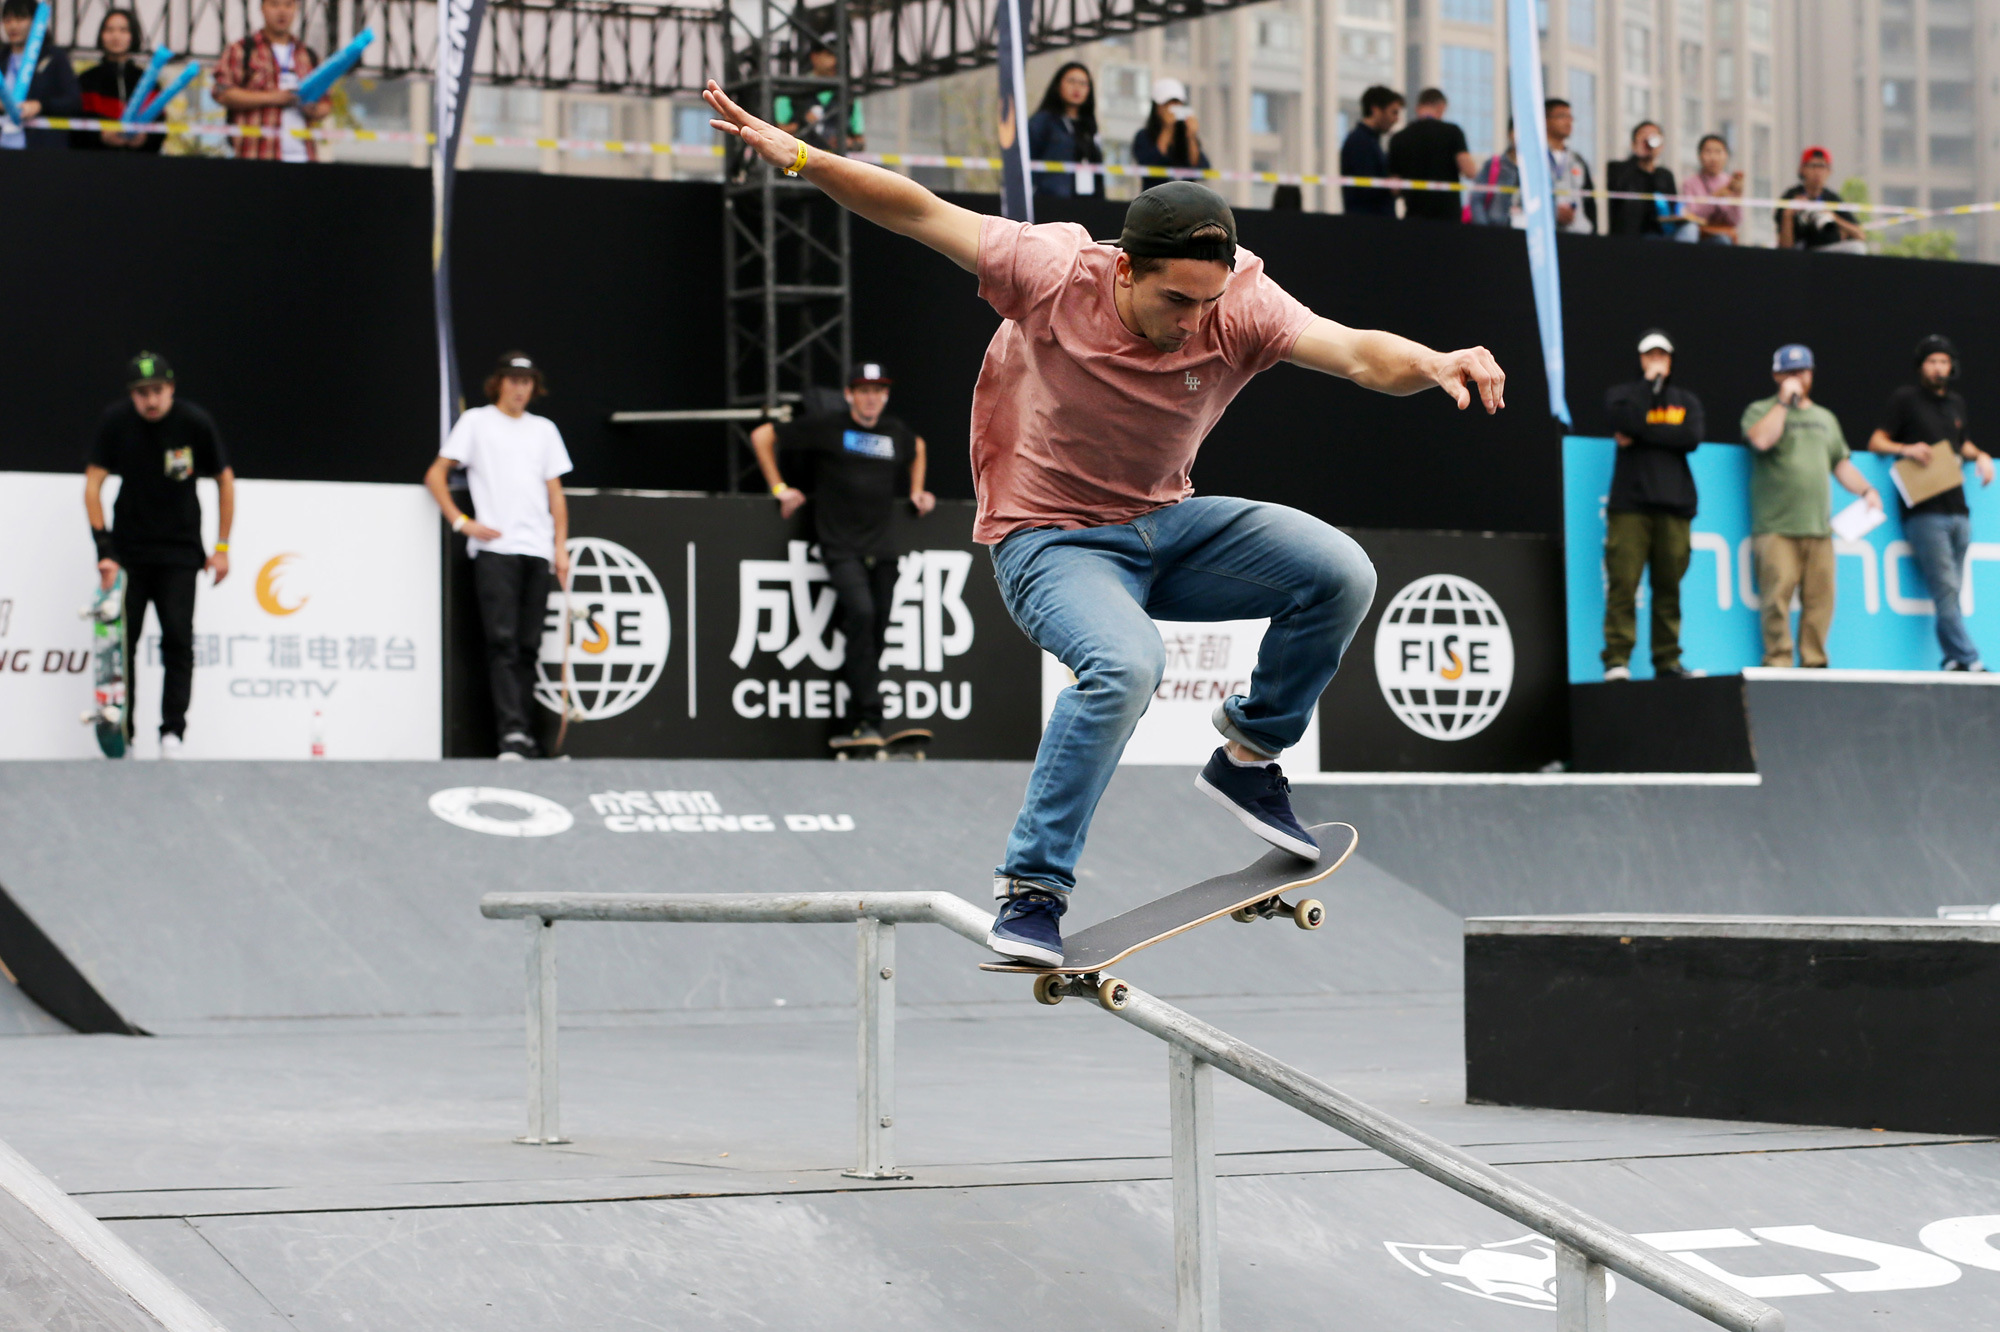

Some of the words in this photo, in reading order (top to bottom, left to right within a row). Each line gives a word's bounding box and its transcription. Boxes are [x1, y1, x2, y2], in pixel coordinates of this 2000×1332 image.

[729, 539, 974, 672] 成都
[43, 650, 88, 673] DU
[1401, 635, 1490, 680] FISE
[604, 814, 776, 832] CHENG
[784, 814, 856, 832] DU
